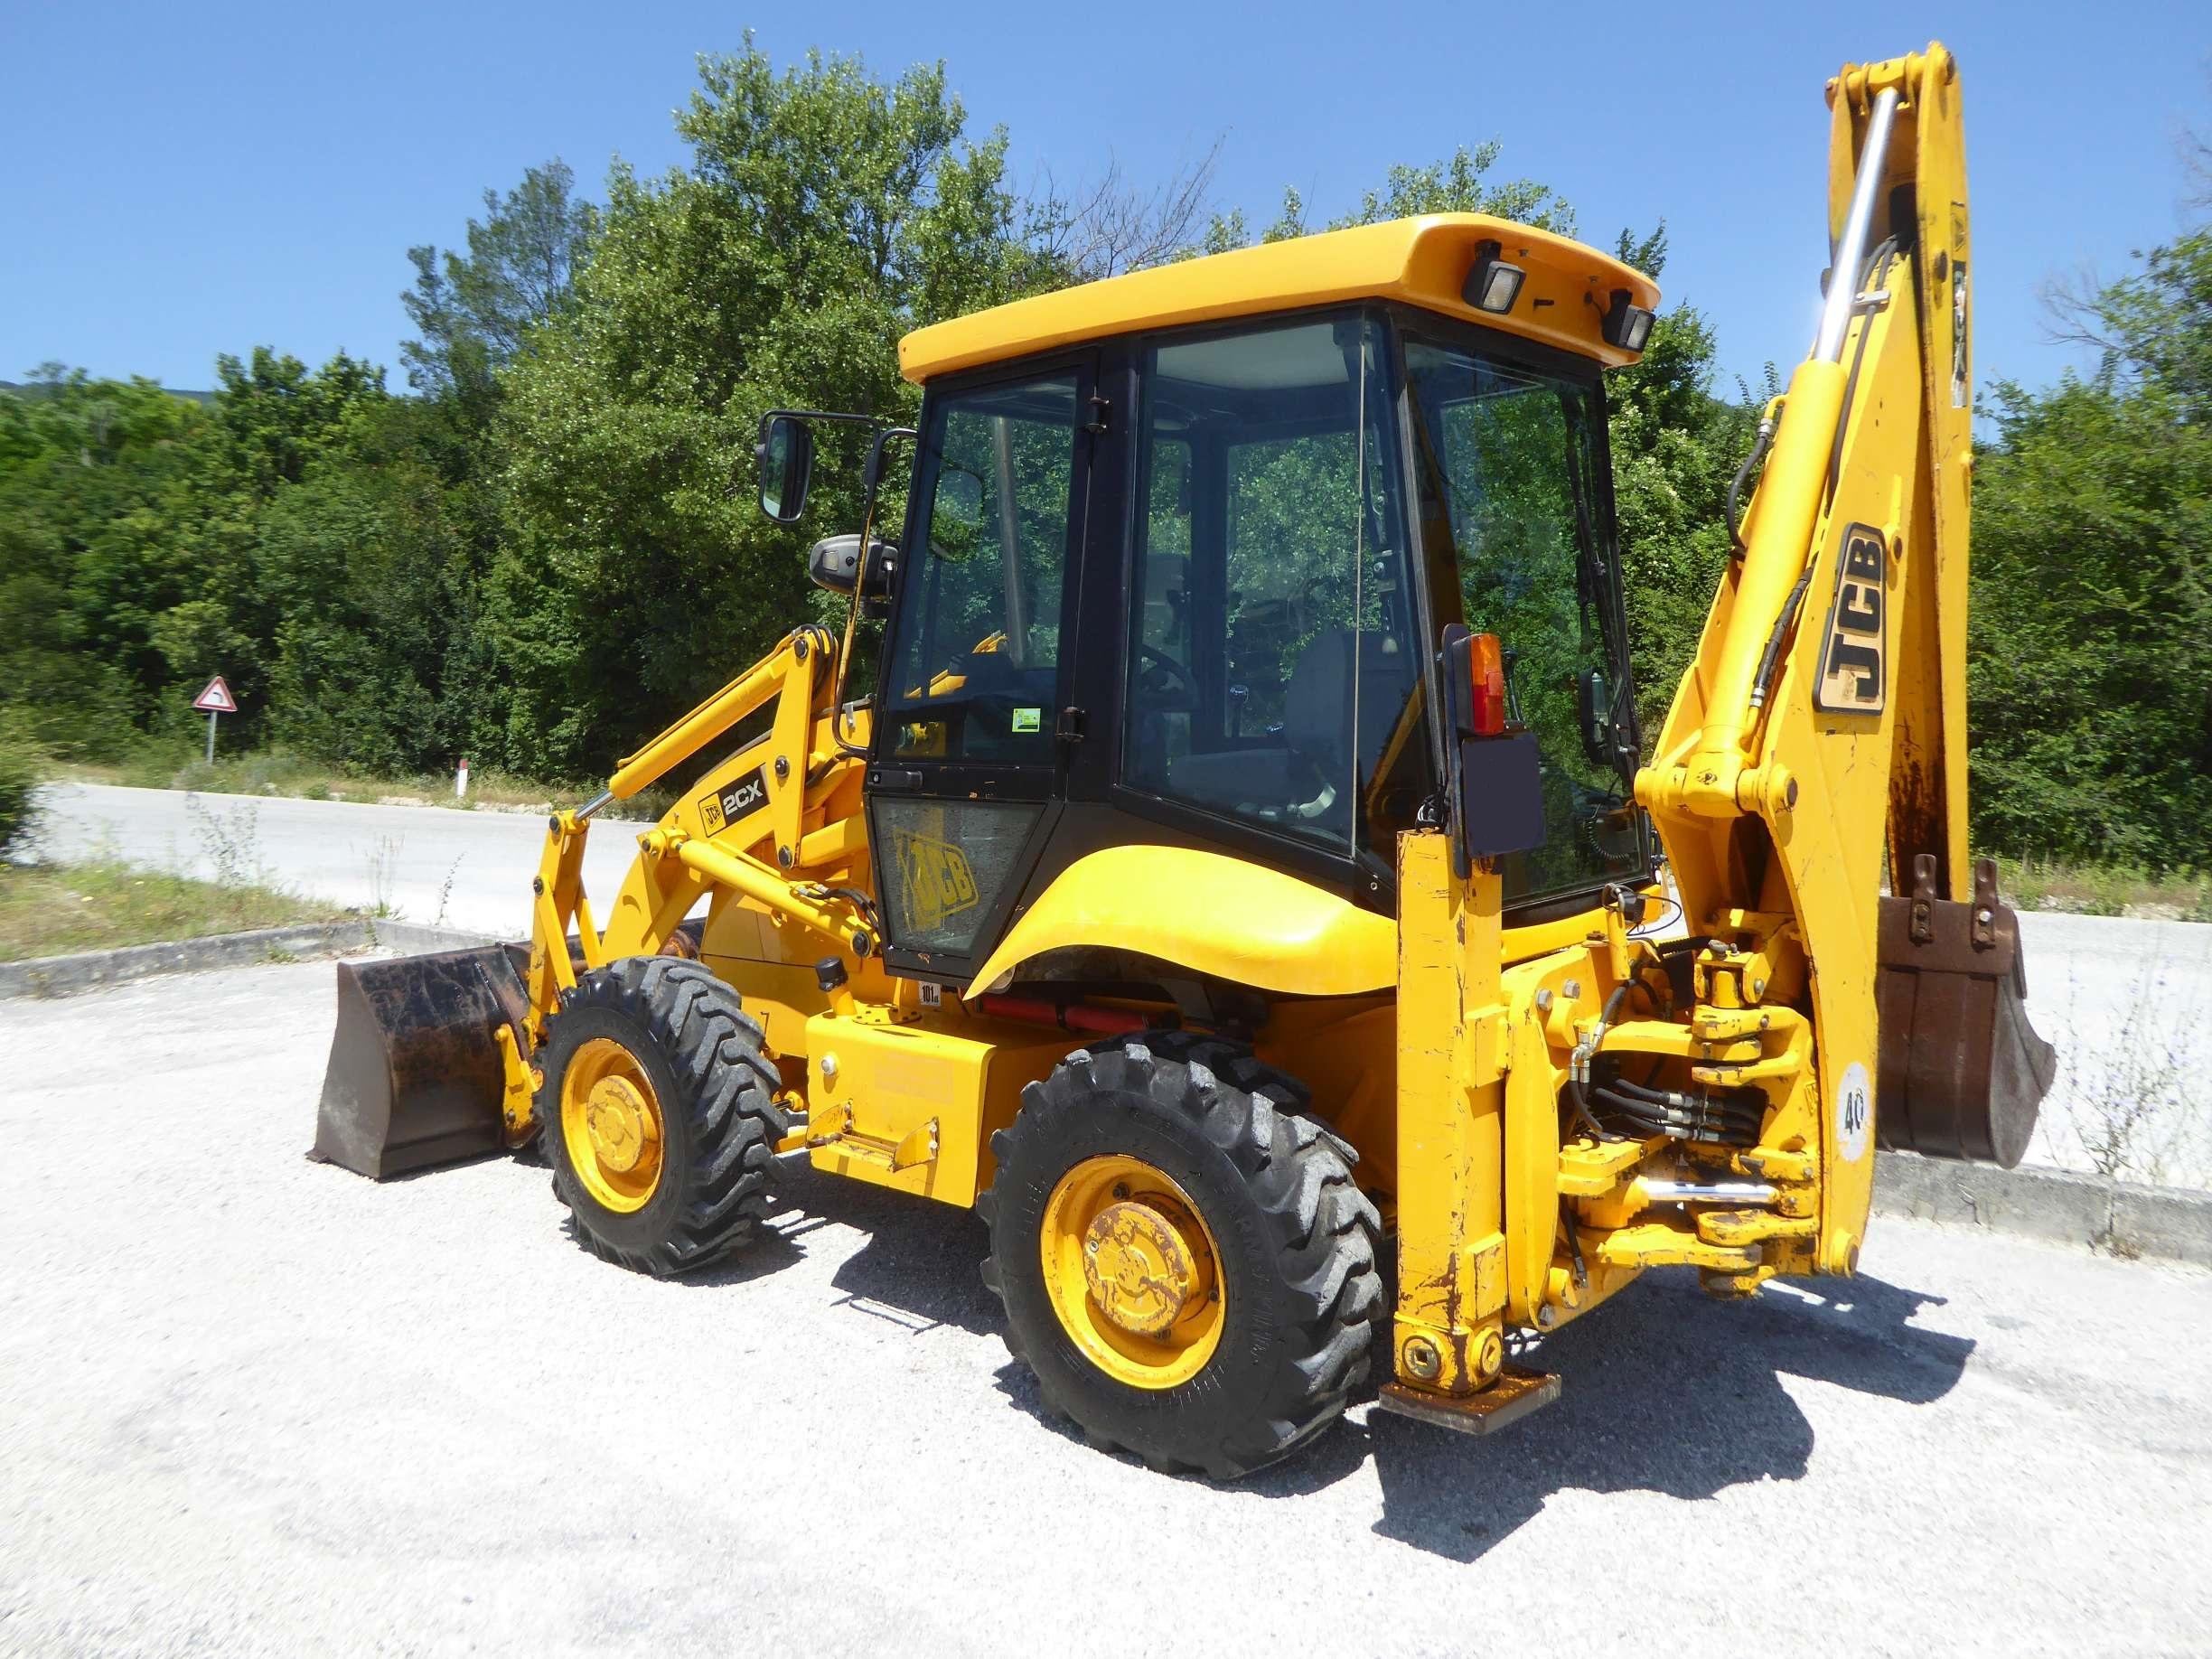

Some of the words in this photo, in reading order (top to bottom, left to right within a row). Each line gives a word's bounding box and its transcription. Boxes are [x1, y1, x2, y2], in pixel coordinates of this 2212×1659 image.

[1828, 538, 1881, 701] JCB
[705, 805, 721, 824] JCB
[723, 779, 764, 815] 2CX
